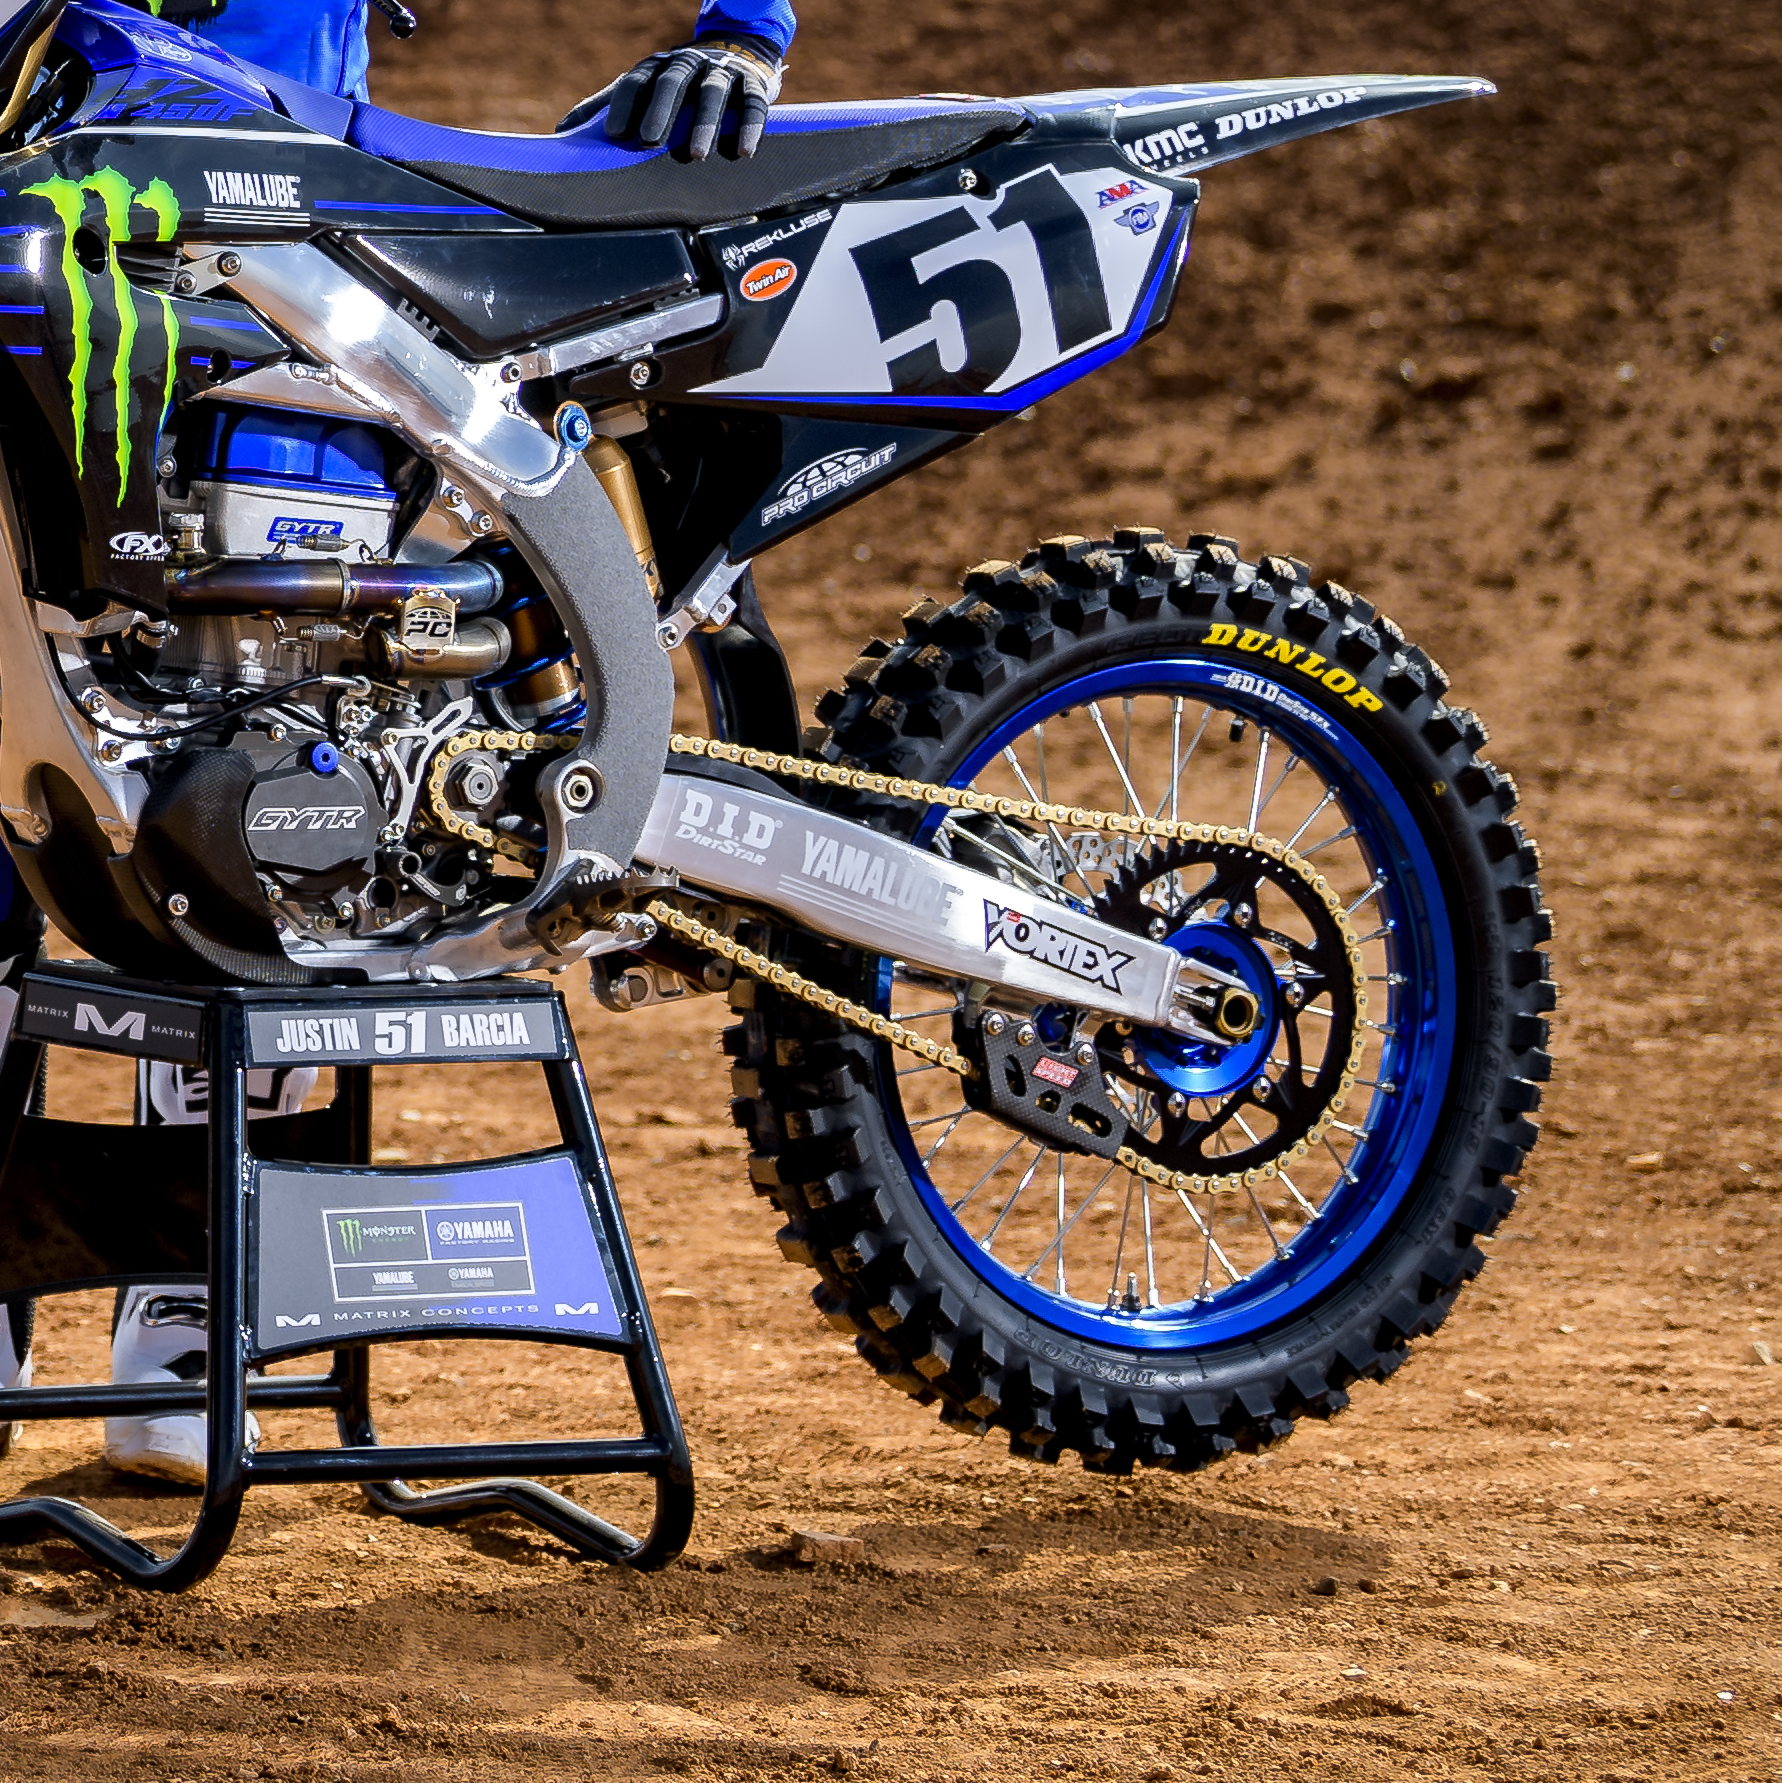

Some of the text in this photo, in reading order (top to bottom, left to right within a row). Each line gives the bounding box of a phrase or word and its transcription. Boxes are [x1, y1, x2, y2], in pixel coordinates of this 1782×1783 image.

[1123, 87, 1367, 167] KMC DUNLOP
[203, 170, 300, 209] YAMALUBE
[1096, 179, 1150, 210] AMA
[741, 208, 833, 258] REKLUSE
[746, 265, 792, 296] Twin Air
[849, 163, 1113, 394] 51
[762, 442, 897, 526] PRO CIRCUIT
[109, 531, 167, 555] FX
[275, 521, 336, 533] GYTR
[405, 617, 452, 638] PC
[1201, 623, 1383, 712] DUNLOP
[247, 804, 366, 831] GYTR
[800, 830, 957, 926] YAMALUBE
[983, 898, 1136, 995] VORTEX
[27, 1003, 70, 1019] MATRIX
[150, 1024, 197, 1040] MATRIX
[276, 1011, 531, 1056] JUSTIN 51 BARCIA
[362, 1224, 416, 1237] MONSTER
[453, 1220, 515, 1240] YAMAHA
[458, 1267, 495, 1280] YAMAHA
[333, 1308, 411, 1321] MATRIX
[421, 1304, 539, 1317] CONCEPTS
